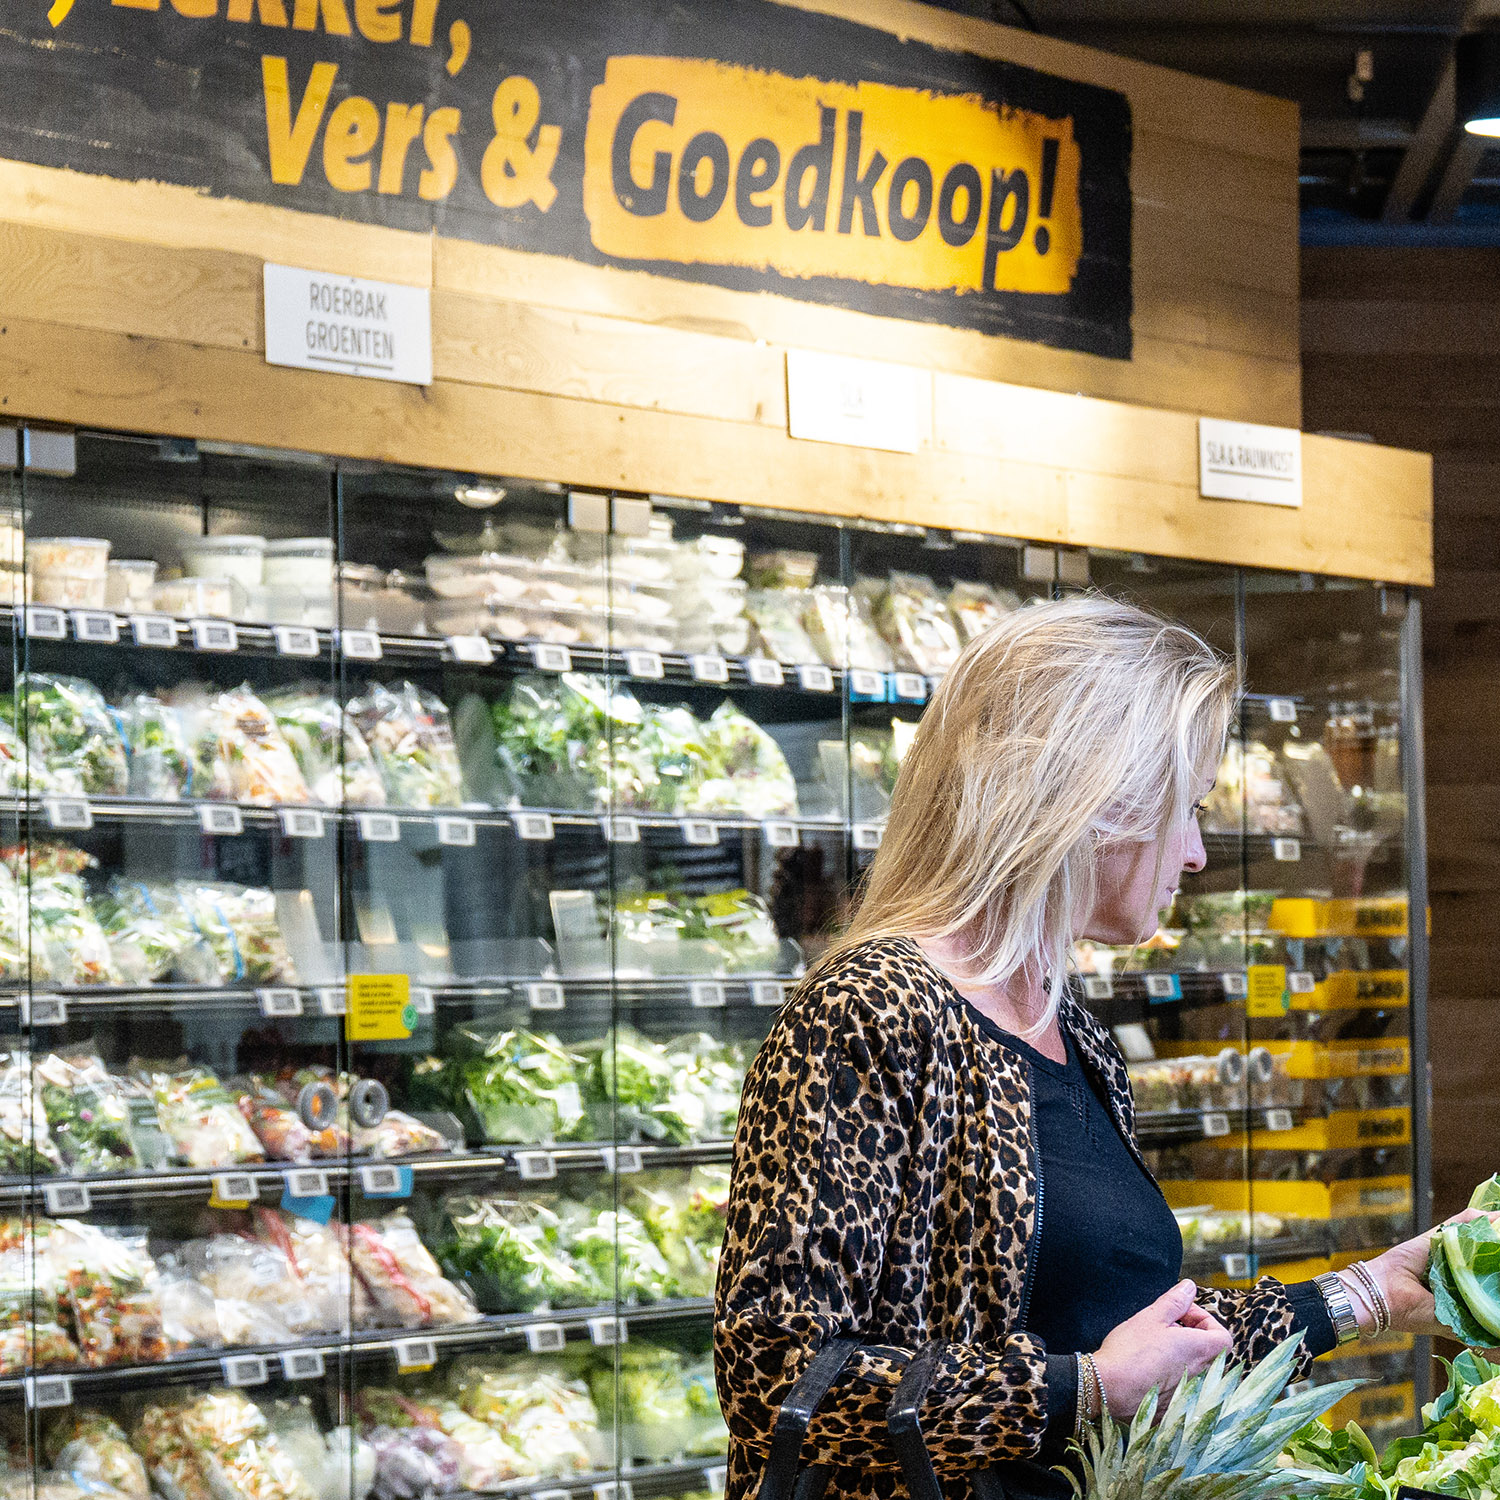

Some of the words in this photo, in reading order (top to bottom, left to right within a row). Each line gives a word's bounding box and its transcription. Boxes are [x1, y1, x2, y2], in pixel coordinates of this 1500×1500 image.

[261, 54, 461, 200] Vers
[480, 75, 562, 212] &
[606, 90, 1061, 289] Goedkoop!
[305, 320, 394, 359] GROENTEN
[309, 282, 388, 320] ROERBAK
